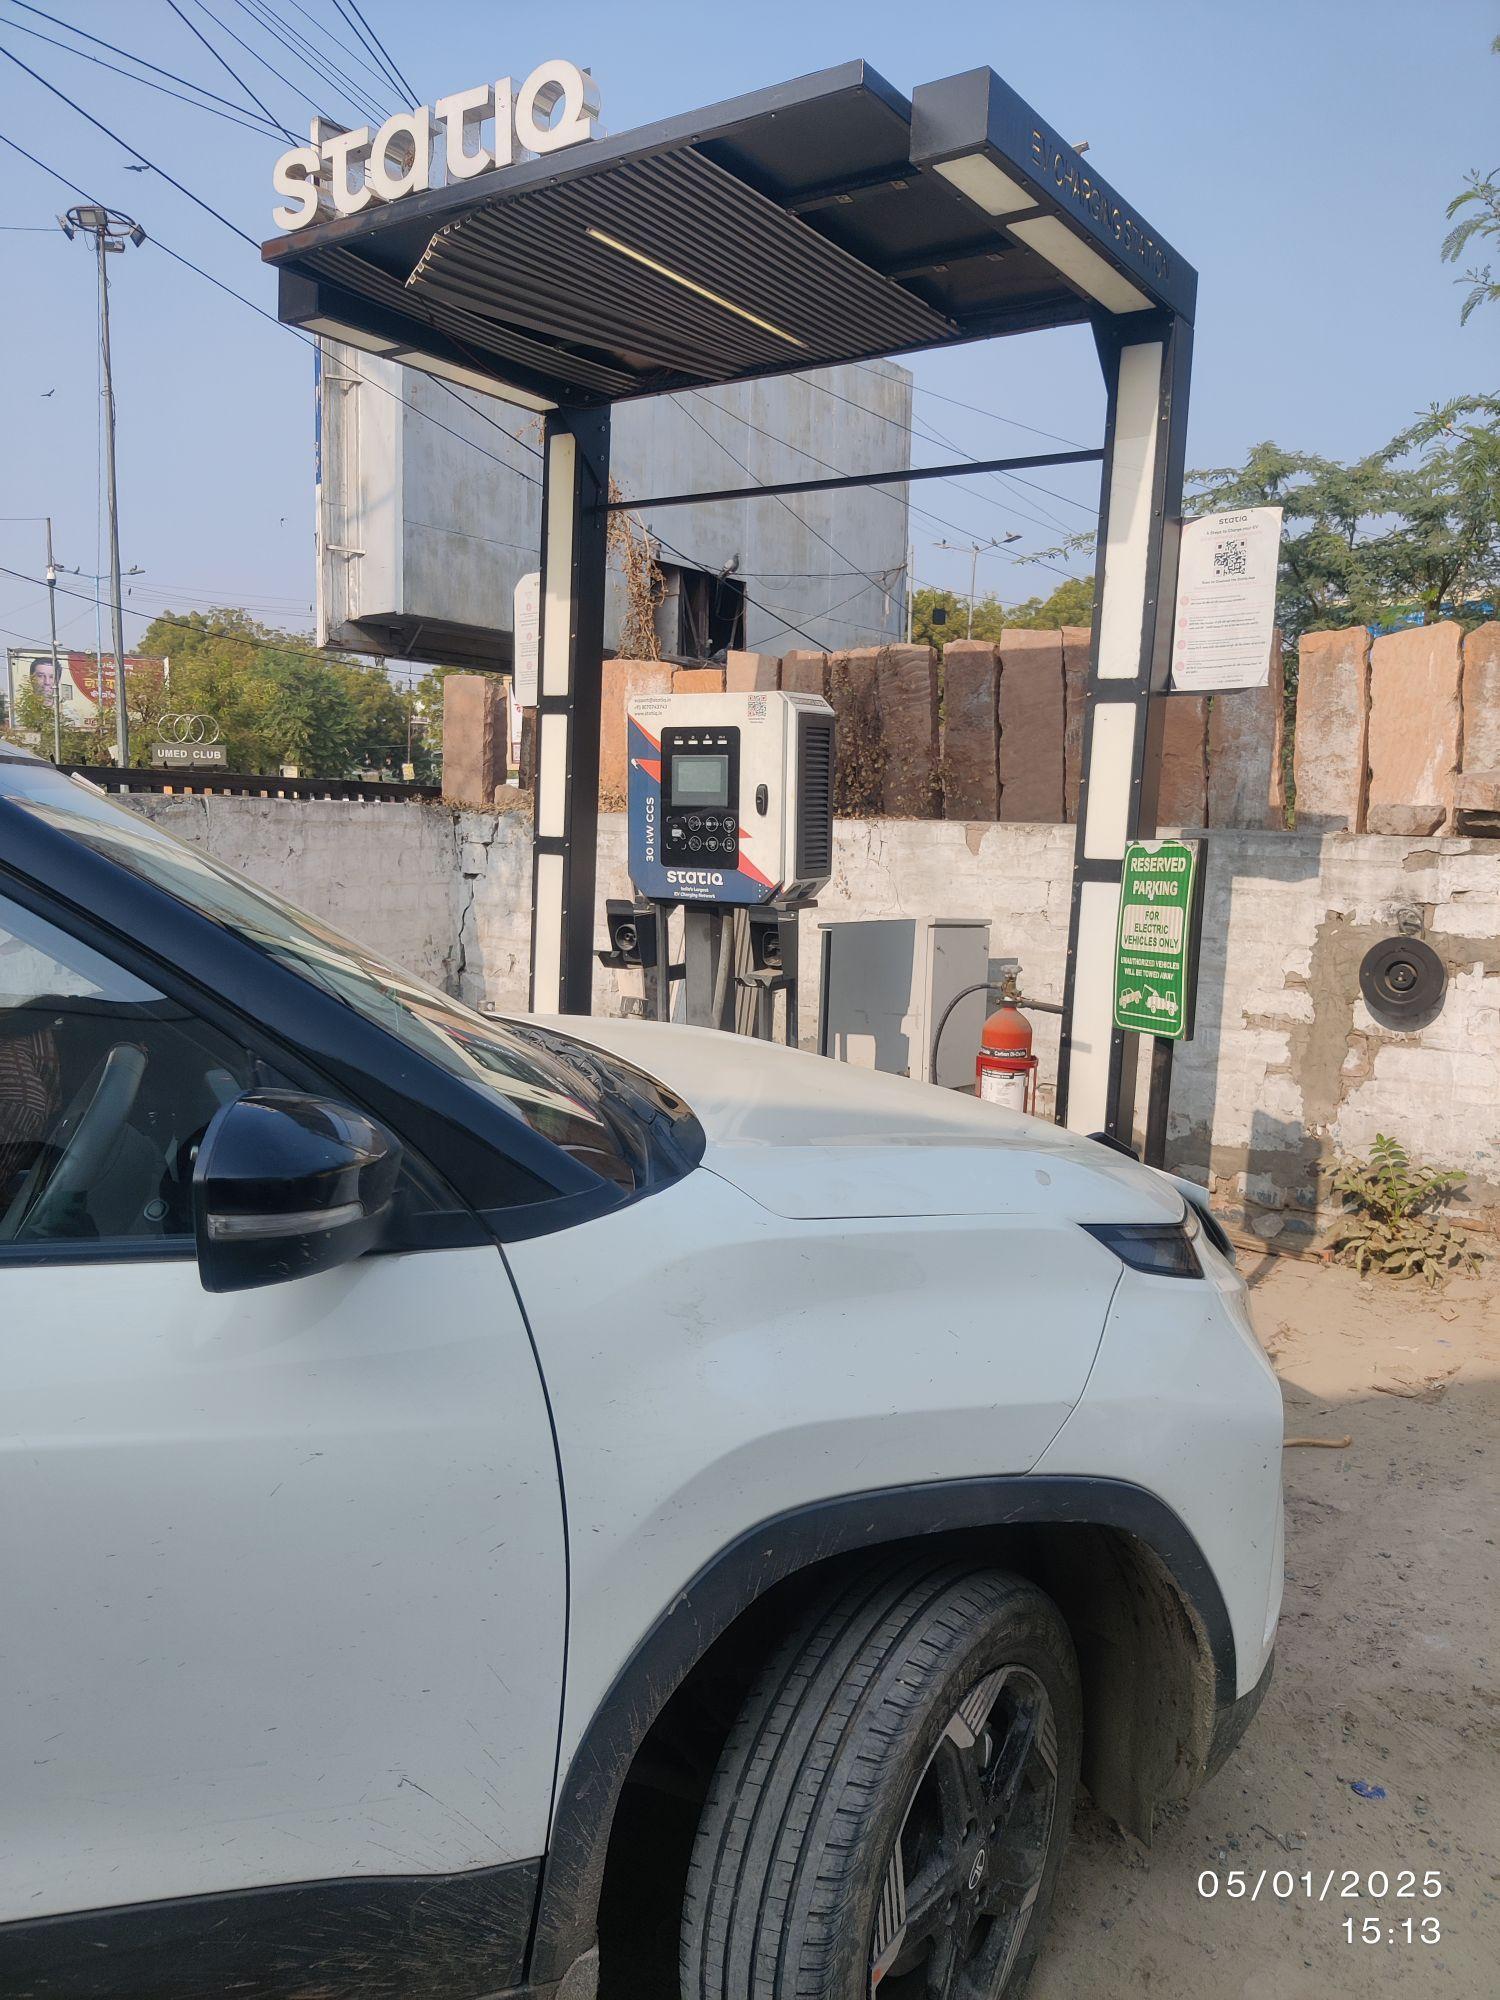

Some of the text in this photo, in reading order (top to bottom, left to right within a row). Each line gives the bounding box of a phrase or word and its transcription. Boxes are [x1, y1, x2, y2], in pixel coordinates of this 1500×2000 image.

[1031, 129, 1052, 174] EV
[1054, 152, 1121, 241] CHARGING
[157, 749, 222, 759] UMED CLUB
[645, 797, 655, 862] 30 kW CCS
[1130, 857, 1187, 872] RESERVED
[1132, 880, 1178, 896] PARKING
[1144, 910, 1160, 921] FOR
[1134, 923, 1169, 934] ELECTRIC
[1123, 935, 1179, 949] VEHICLES ONLY
[1155, 960, 1180, 970] VEHICLES
[1124, 967, 1174, 980] WILL BE TOWED AWAY
